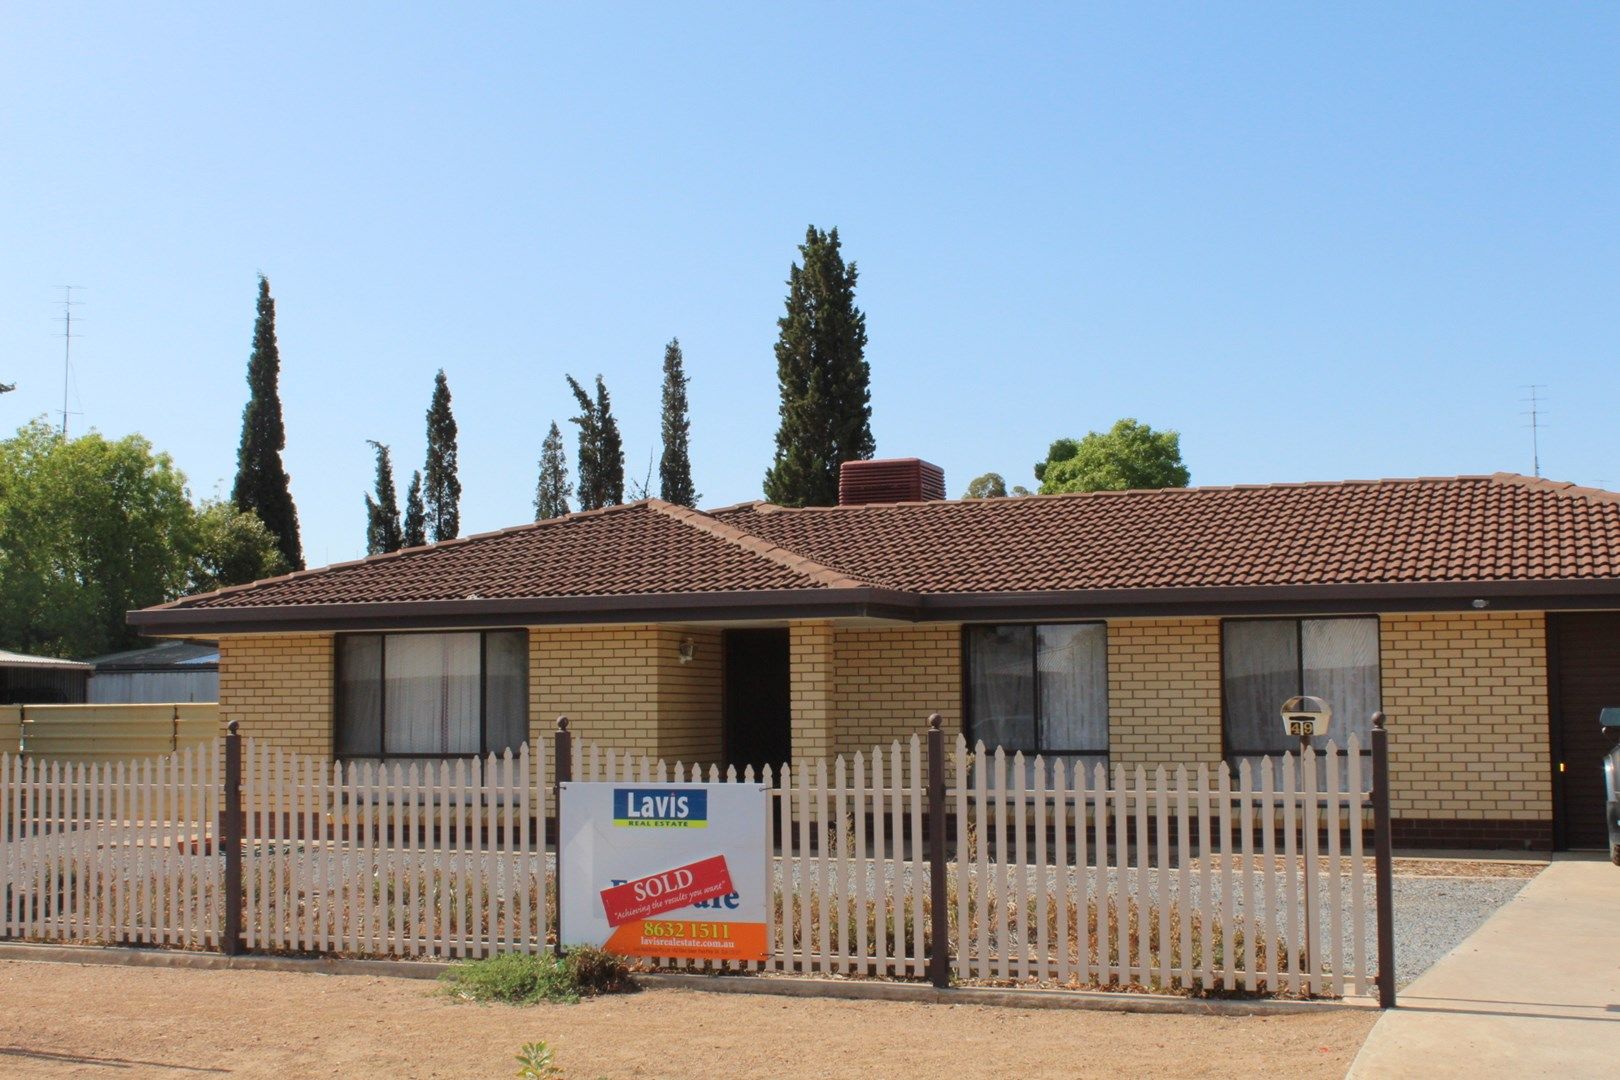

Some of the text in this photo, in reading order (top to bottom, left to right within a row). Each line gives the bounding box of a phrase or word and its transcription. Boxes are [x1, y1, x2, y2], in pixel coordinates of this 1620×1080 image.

[1291, 722, 1313, 734] 49
[628, 792, 689, 818] Lavis
[633, 869, 693, 902] SOLD
[651, 899, 663, 910] the
[664, 892, 688, 905] results
[689, 889, 703, 903] you
[644, 921, 730, 938] 8632 1511
[641, 936, 735, 948] lavisrealestate.com.au
